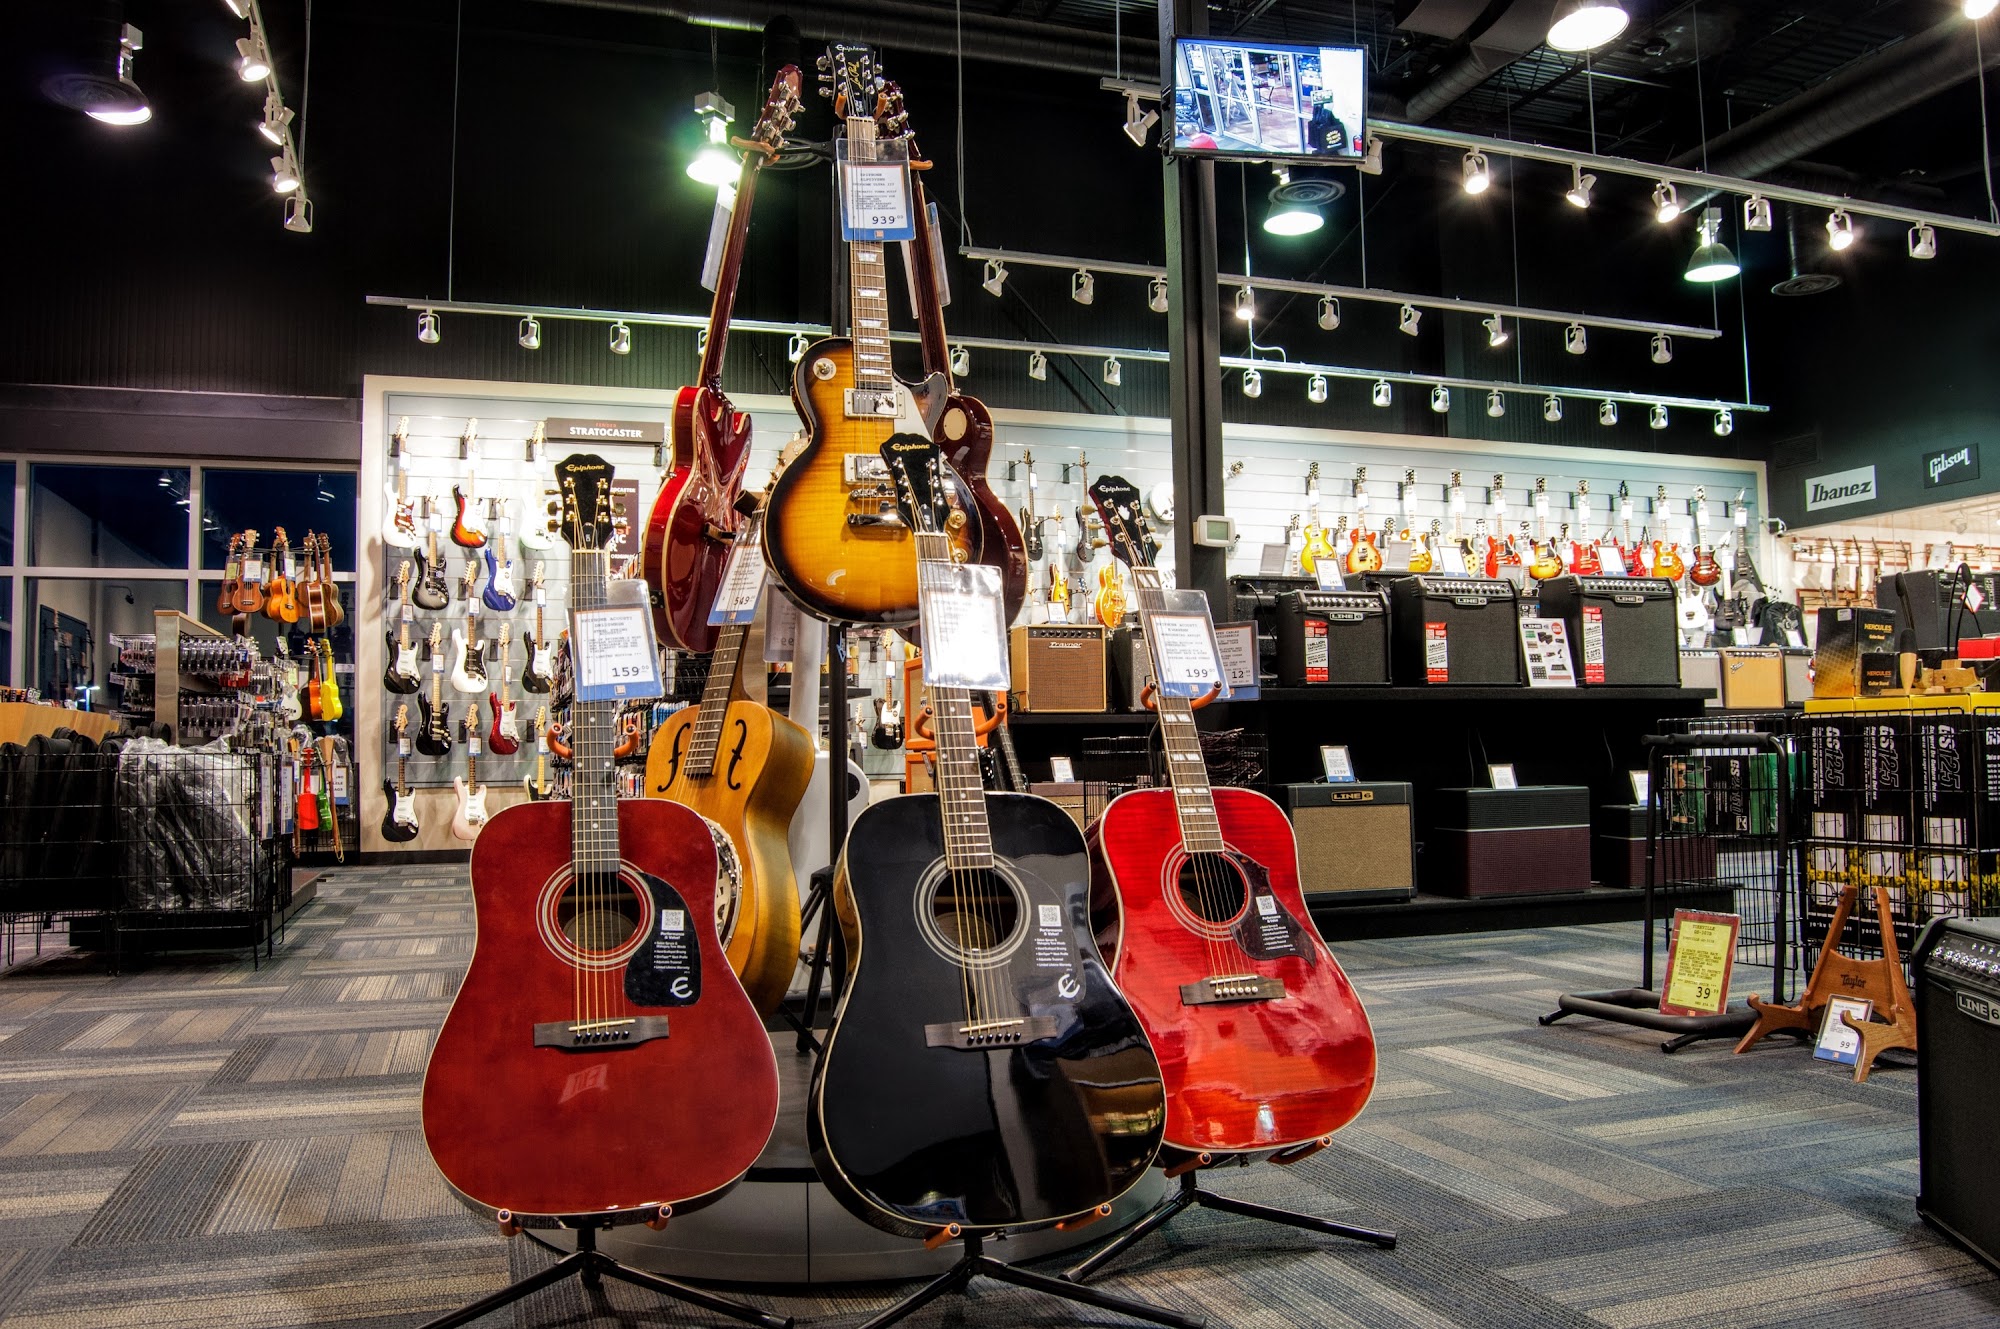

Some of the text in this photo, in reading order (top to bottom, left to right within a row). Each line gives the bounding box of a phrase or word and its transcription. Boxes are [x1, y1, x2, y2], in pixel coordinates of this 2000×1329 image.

[835, 44, 868, 52] Epiphone
[570, 427, 642, 438] STRATOCASTER
[891, 443, 930, 451] Epiphone
[565, 464, 605, 472] Epiphone
[1929, 448, 1971, 483] Gibson
[1098, 485, 1131, 493] Epiphone
[1810, 480, 1872, 504] Ibanez
[1825, 726, 1844, 786] GS125
[1879, 726, 1899, 787] GS125
[1938, 725, 1960, 789] GS125
[1840, 974, 1866, 989] Taylor
[1959, 996, 2000, 1019] LINE 6
